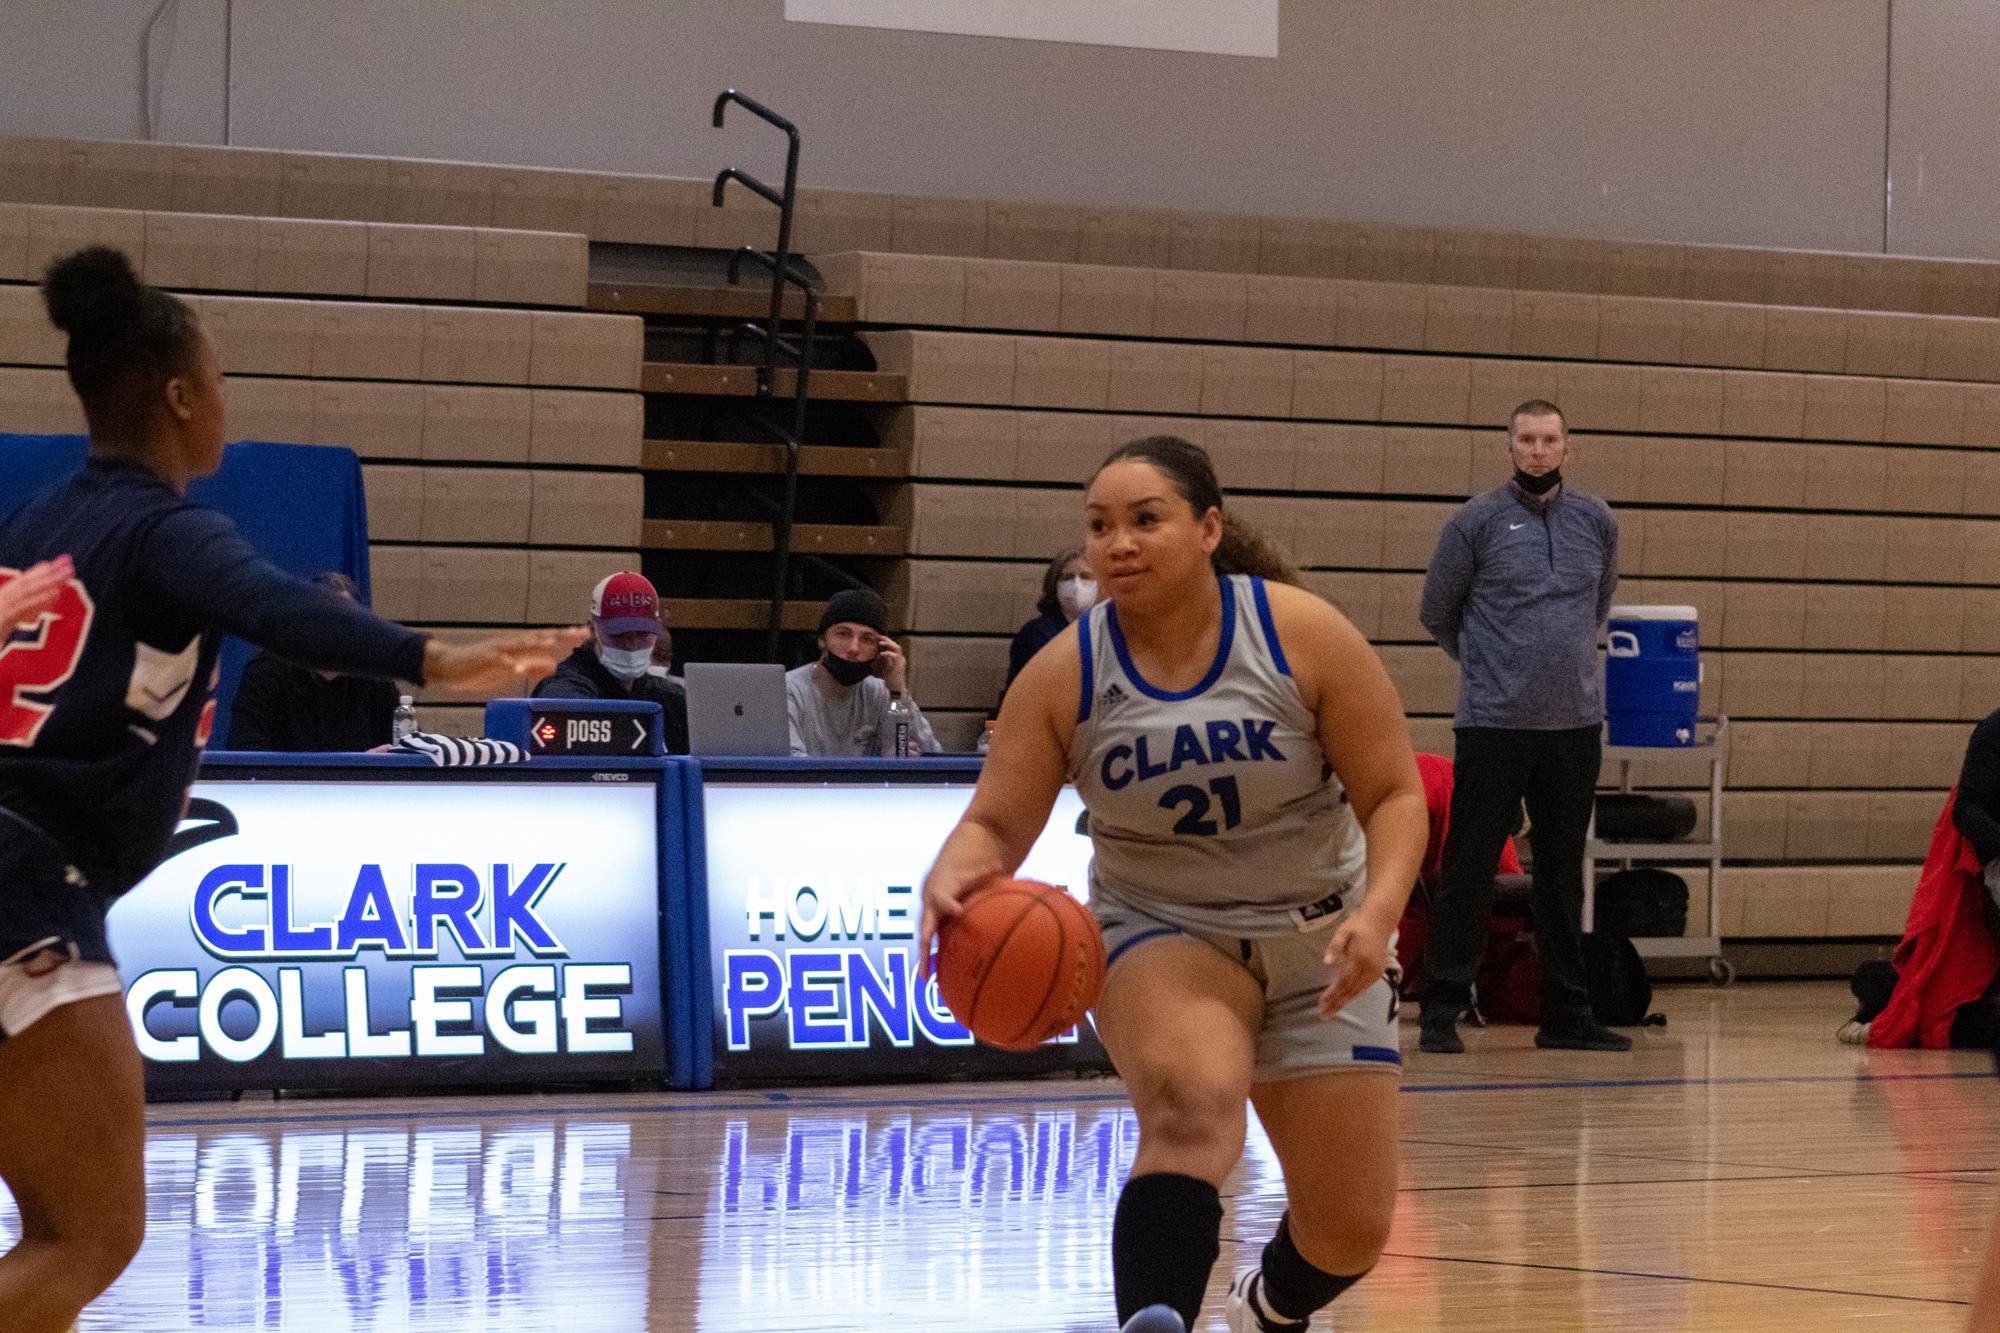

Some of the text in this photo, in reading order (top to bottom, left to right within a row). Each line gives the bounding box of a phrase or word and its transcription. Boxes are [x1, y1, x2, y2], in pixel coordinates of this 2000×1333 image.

[1101, 718, 1287, 791] CLARK
[1157, 774, 1242, 836] 21
[190, 862, 570, 962] CLARK
[746, 876, 915, 943] HOME
[126, 962, 635, 1062] COLLEGE
